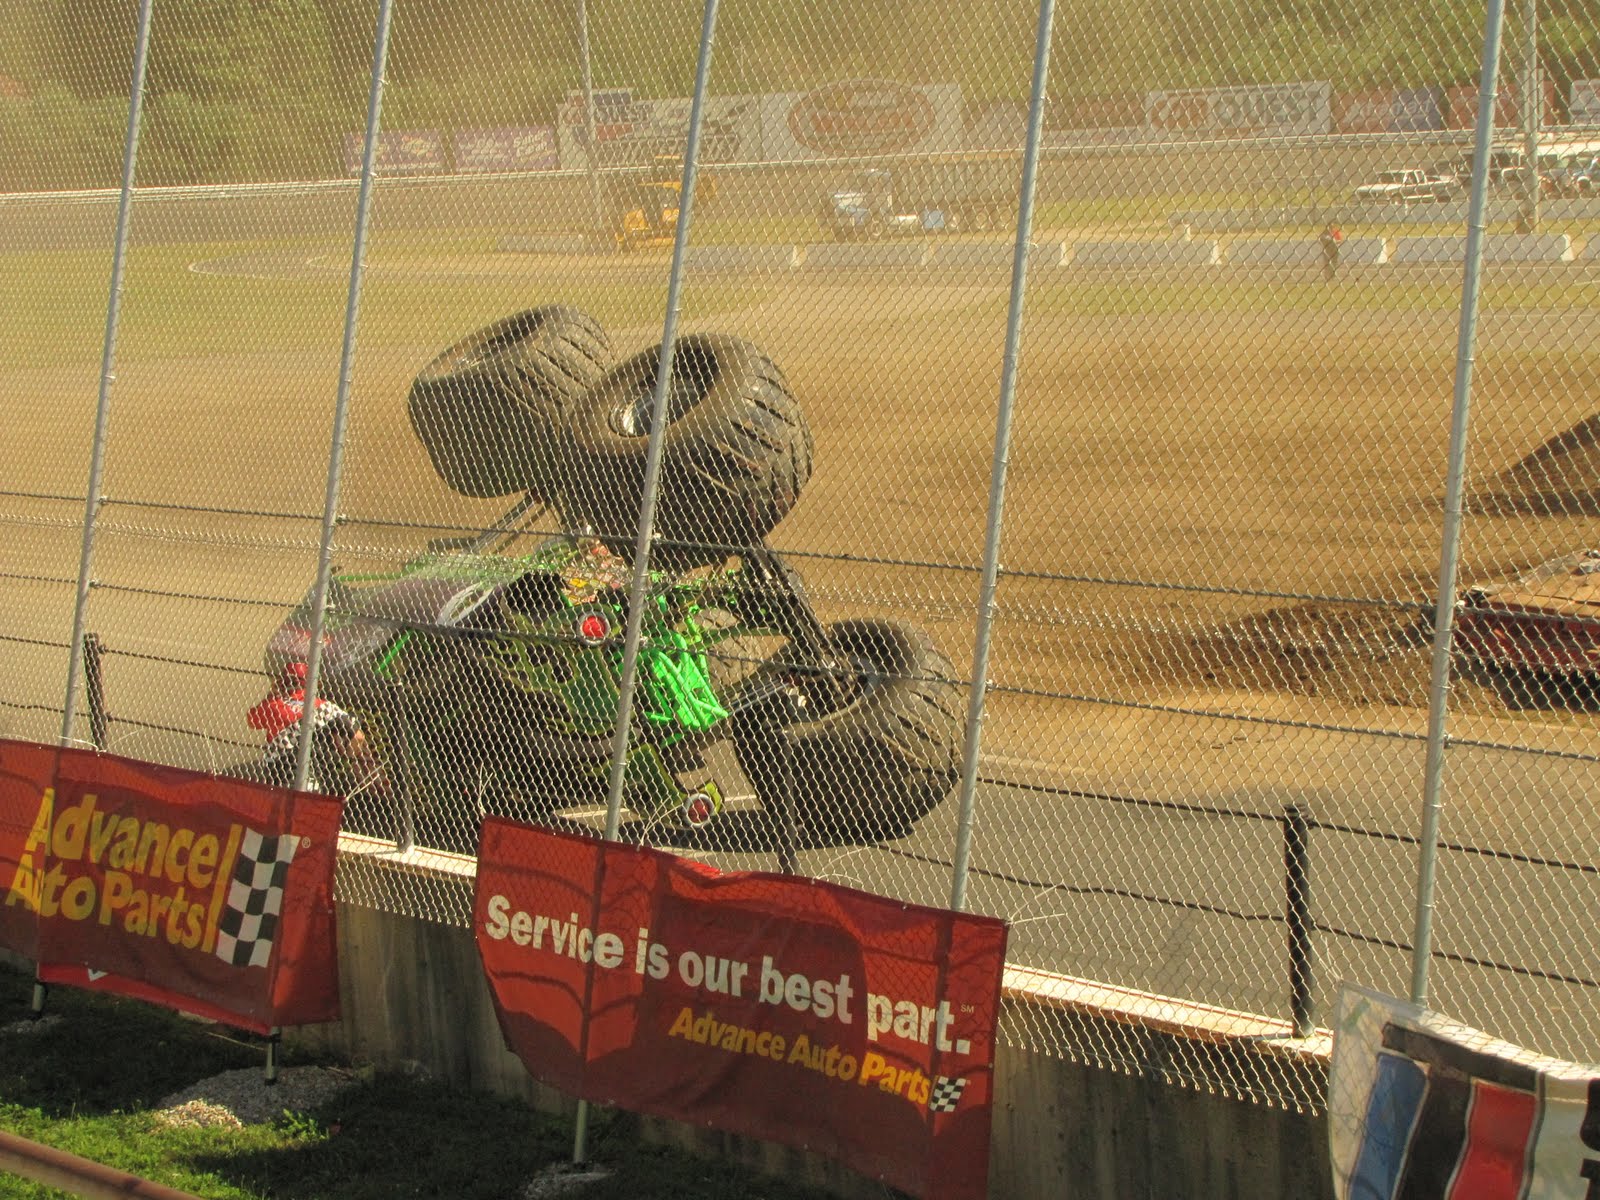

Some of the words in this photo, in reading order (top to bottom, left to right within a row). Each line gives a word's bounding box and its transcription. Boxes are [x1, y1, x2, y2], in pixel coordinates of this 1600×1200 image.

[24, 787, 219, 889] Advance
[98, 870, 205, 950] Parts
[485, 894, 624, 969] Service
[635, 927, 670, 980] is
[678, 951, 748, 997] our
[759, 955, 853, 1024] best
[867, 992, 971, 1055] part.
[668, 1007, 786, 1061] Advance
[787, 1034, 858, 1081] Auto
[858, 1051, 931, 1105] Parts
